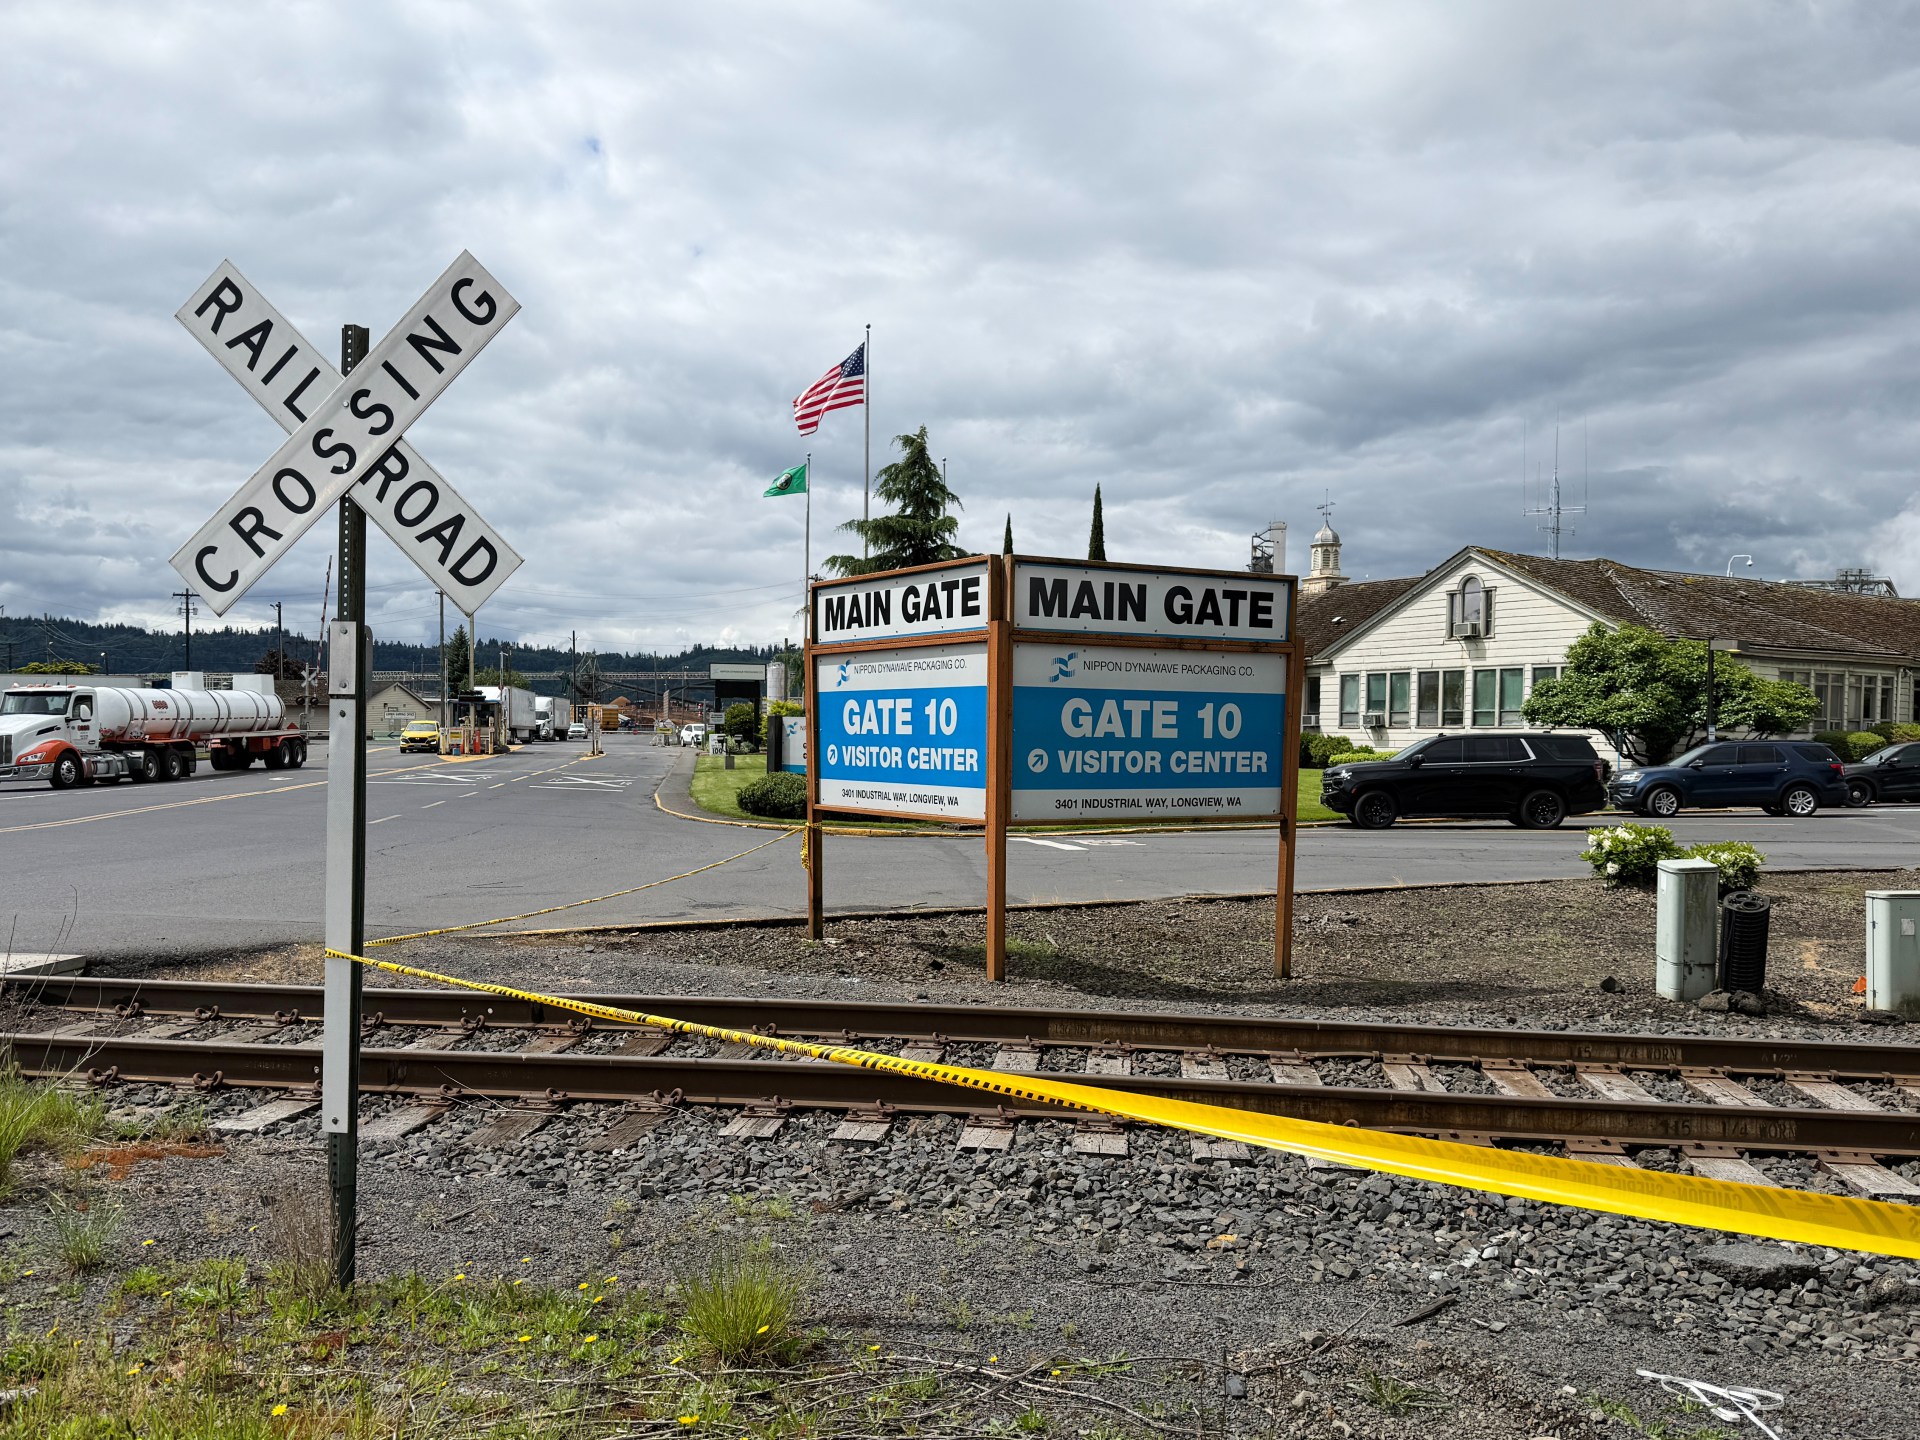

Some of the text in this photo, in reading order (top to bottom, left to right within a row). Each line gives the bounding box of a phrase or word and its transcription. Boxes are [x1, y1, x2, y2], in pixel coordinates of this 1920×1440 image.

[194, 276, 498, 587] RAIL ROAD
[195, 277, 497, 593] CROSSING
[825, 576, 980, 632] MAIN GATE
[1029, 577, 1274, 628] MAIN GATE
[854, 658, 967, 674] NIPPON DYNAWAVE PACKAGING CO.
[1083, 660, 1255, 677] NIPPON DYNAWAVE PACKAGING CO.
[843, 697, 957, 735] GATE 10
[1061, 698, 1242, 739] GATE 10
[841, 746, 978, 771] VISITOR CENTER
[1058, 750, 1268, 773] VISITOR CENTER
[841, 788, 959, 807] 3401 INDUSTRIAL WAY, LONGVIEW, WA
[1055, 796, 1242, 810] 3401 INDUSTRIAL WAY, LONGVIEW, WA
